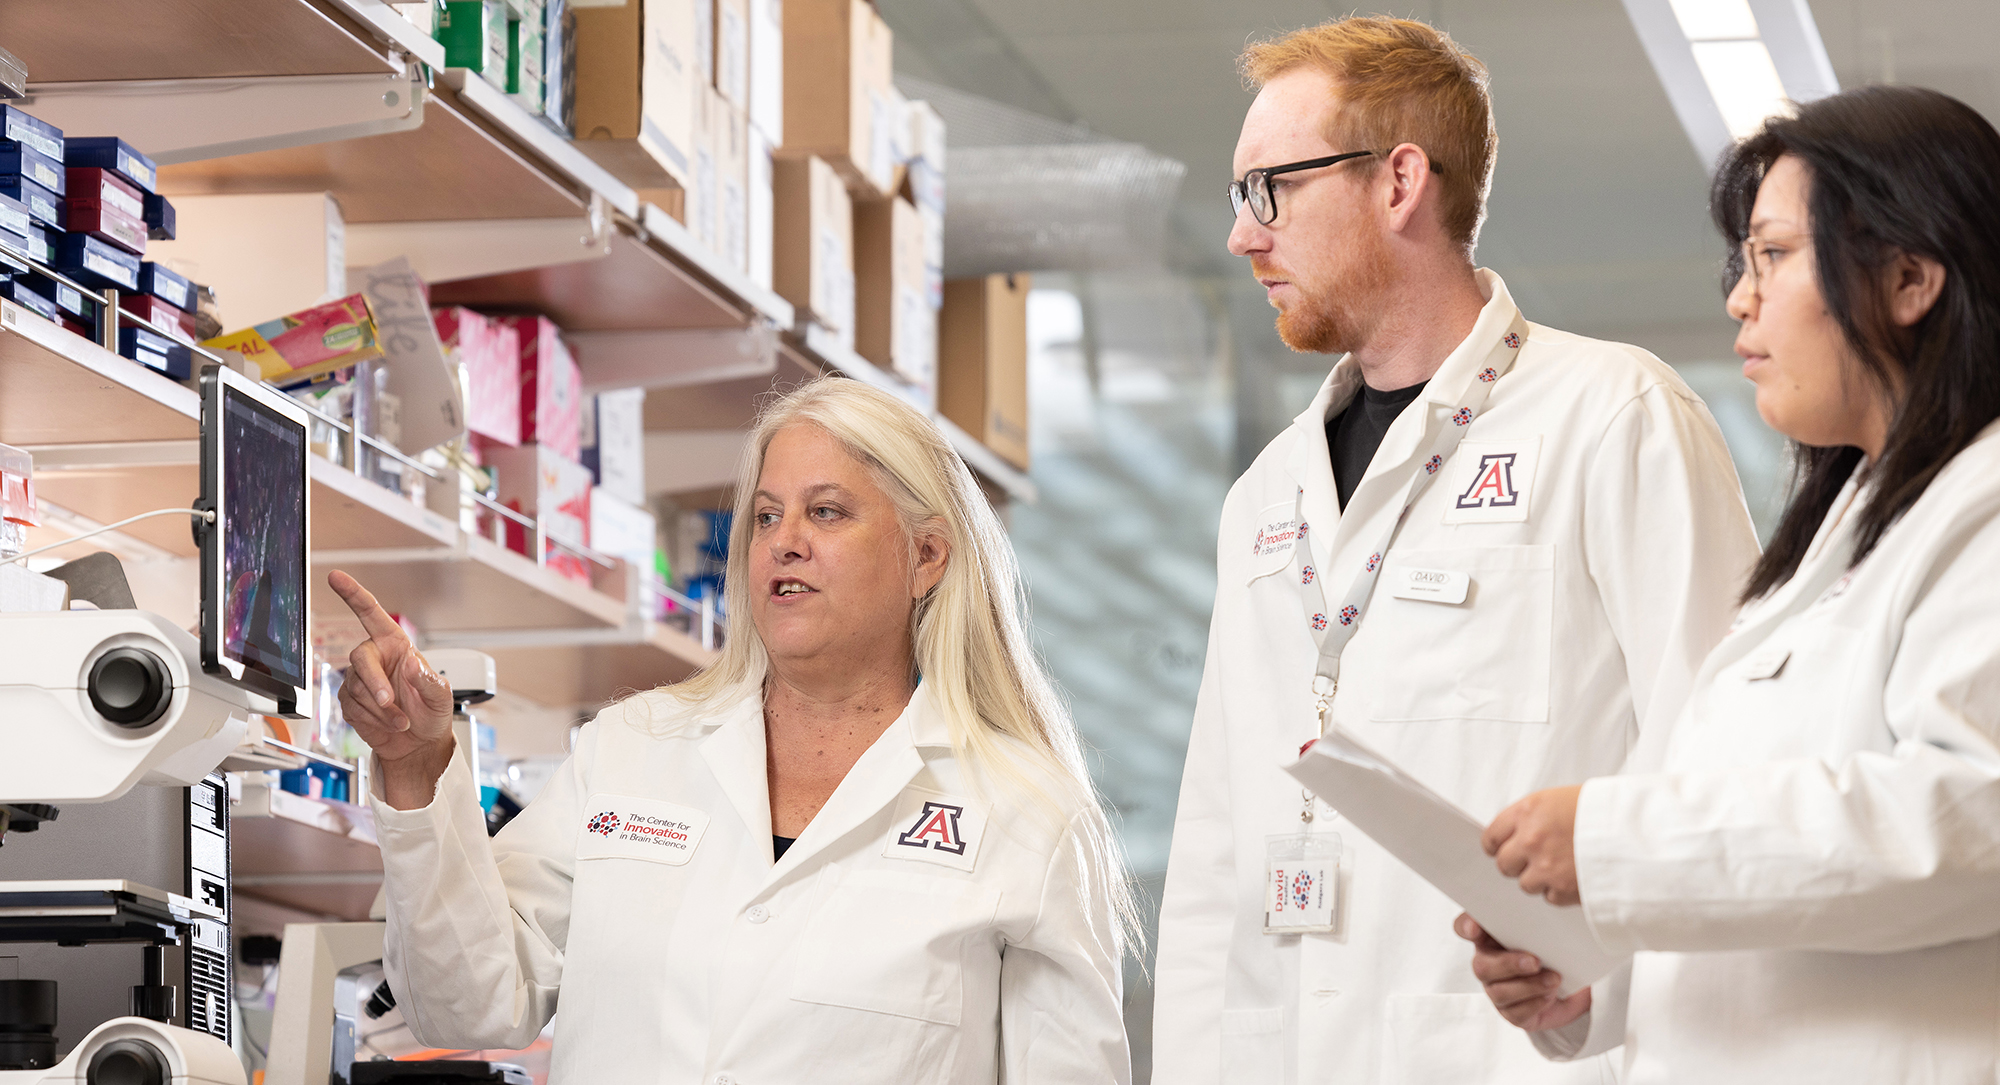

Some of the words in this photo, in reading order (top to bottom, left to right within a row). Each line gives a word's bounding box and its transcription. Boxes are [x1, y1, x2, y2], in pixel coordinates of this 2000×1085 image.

[1456, 453, 1518, 509] A
[1415, 572, 1444, 582] DAVID
[623, 821, 688, 841] Innovation
[629, 813, 646, 823] The
[647, 816, 676, 828] Center
[677, 822, 691, 831] for
[898, 801, 966, 856] A
[619, 832, 628, 840] in
[629, 833, 651, 843] Brain
[652, 836, 687, 851] Science
[1275, 869, 1284, 912] David
